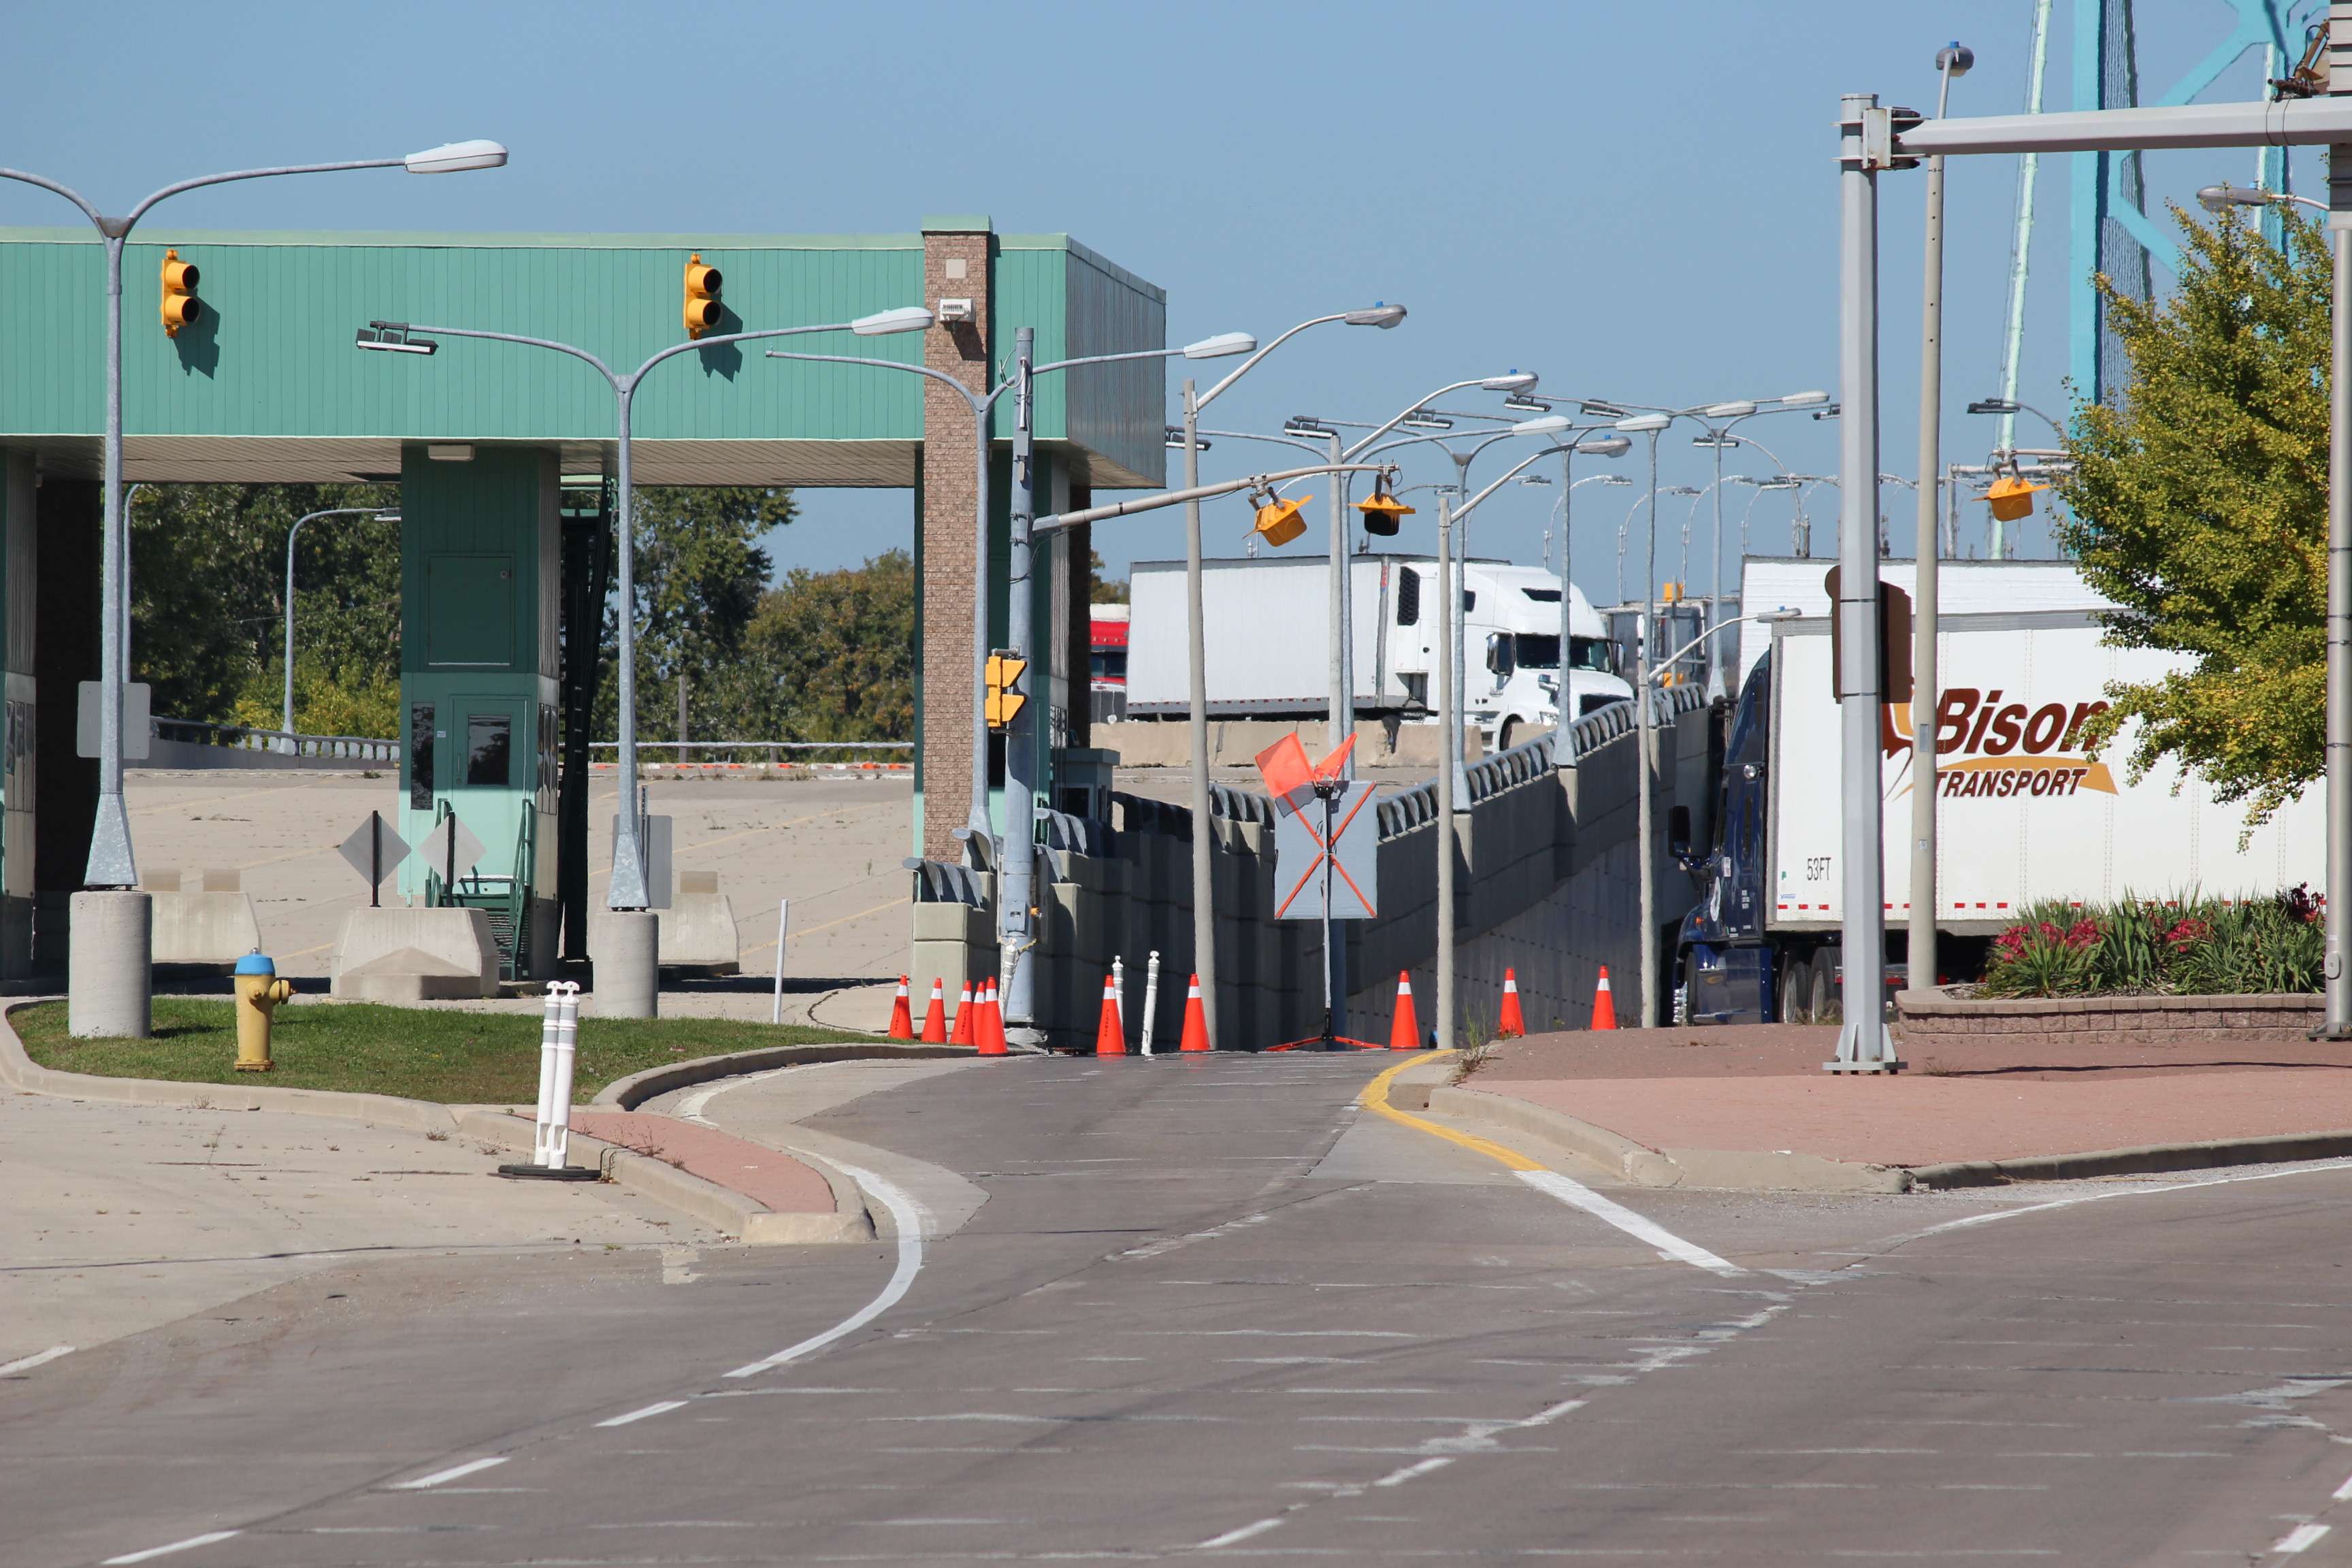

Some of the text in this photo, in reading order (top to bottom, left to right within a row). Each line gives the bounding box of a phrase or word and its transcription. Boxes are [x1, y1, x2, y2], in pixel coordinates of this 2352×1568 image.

[1936, 688, 2109, 755] Bison
[1936, 768, 2089, 797] TRANSPORT
[1807, 857, 1831, 881] 53FT
